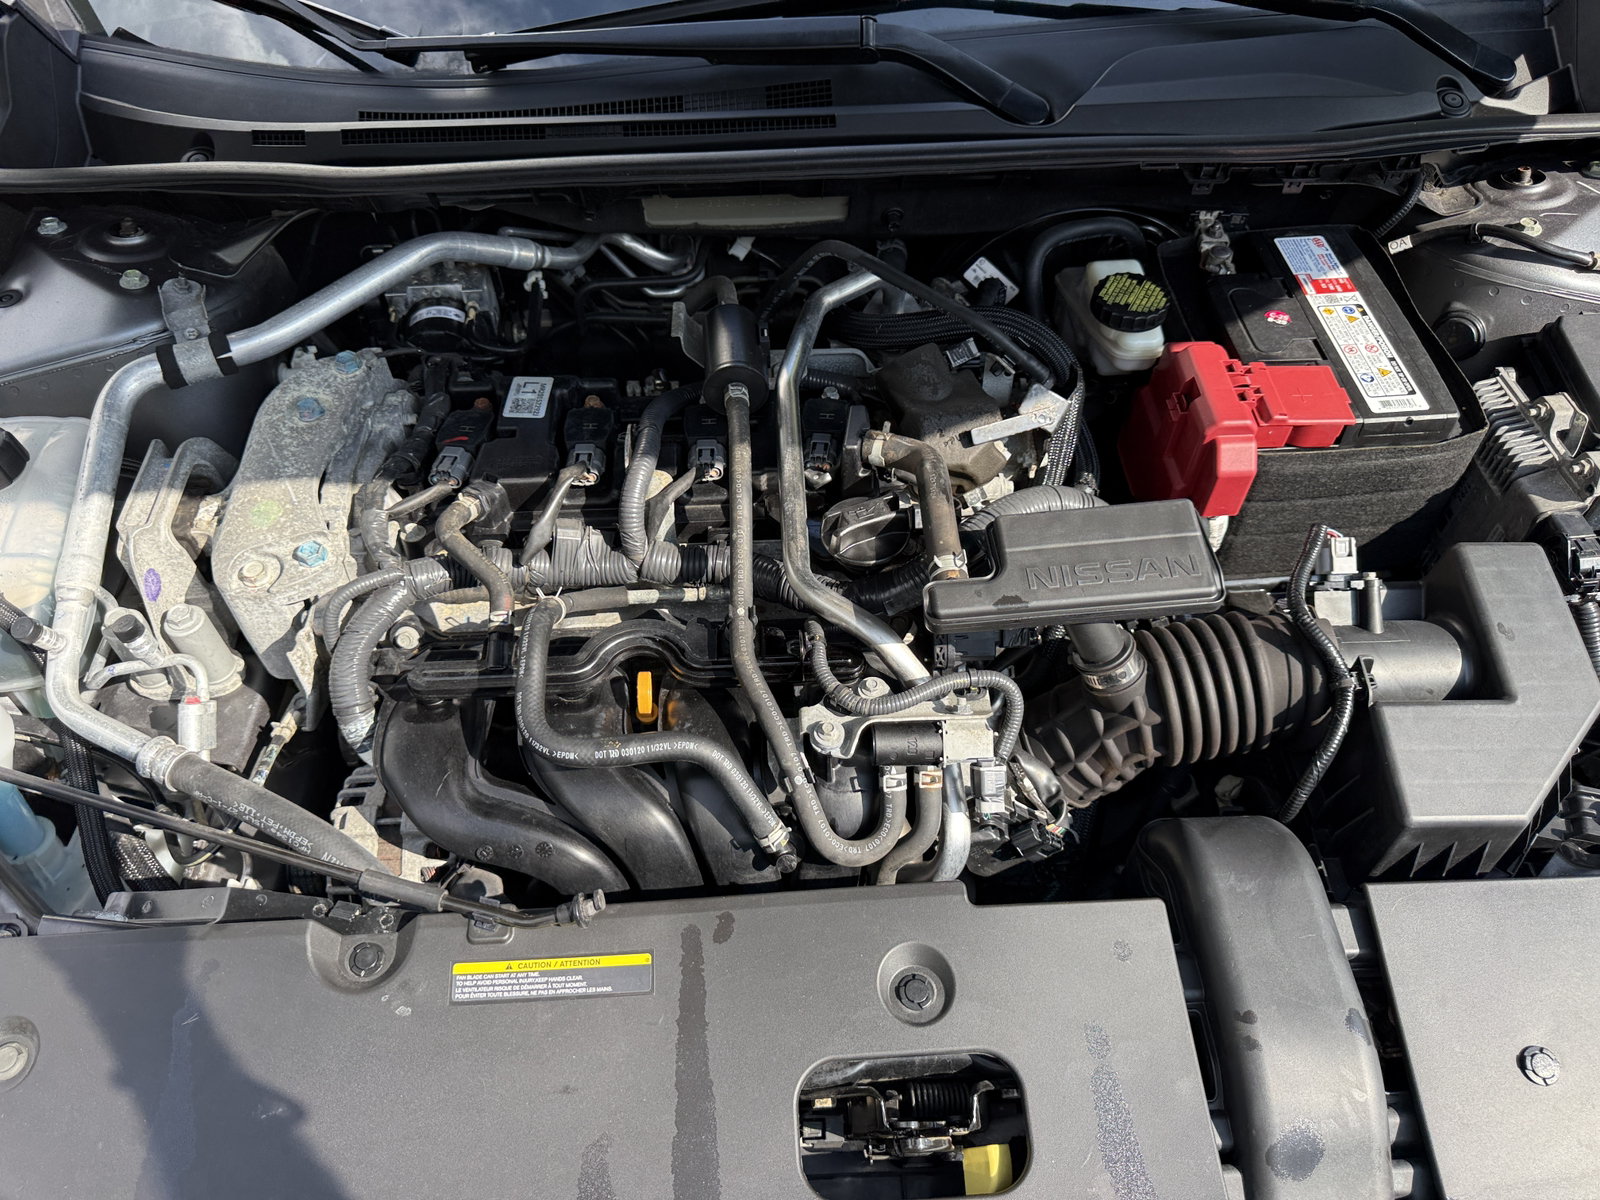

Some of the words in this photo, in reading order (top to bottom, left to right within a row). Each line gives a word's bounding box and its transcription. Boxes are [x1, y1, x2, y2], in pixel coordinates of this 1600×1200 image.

[1024, 554, 1202, 590] NISSAN
[595, 750, 607, 759] DOT
[621, 746, 645, 757] 030120
[647, 743, 672, 754] 11/32VL
[674, 741, 699, 750] >EPDM<
[712, 750, 724, 761] DOT
[730, 767, 749, 790] 030120
[747, 787, 763, 810] 11/32VL
[560, 959, 601, 967] ATTENTION
